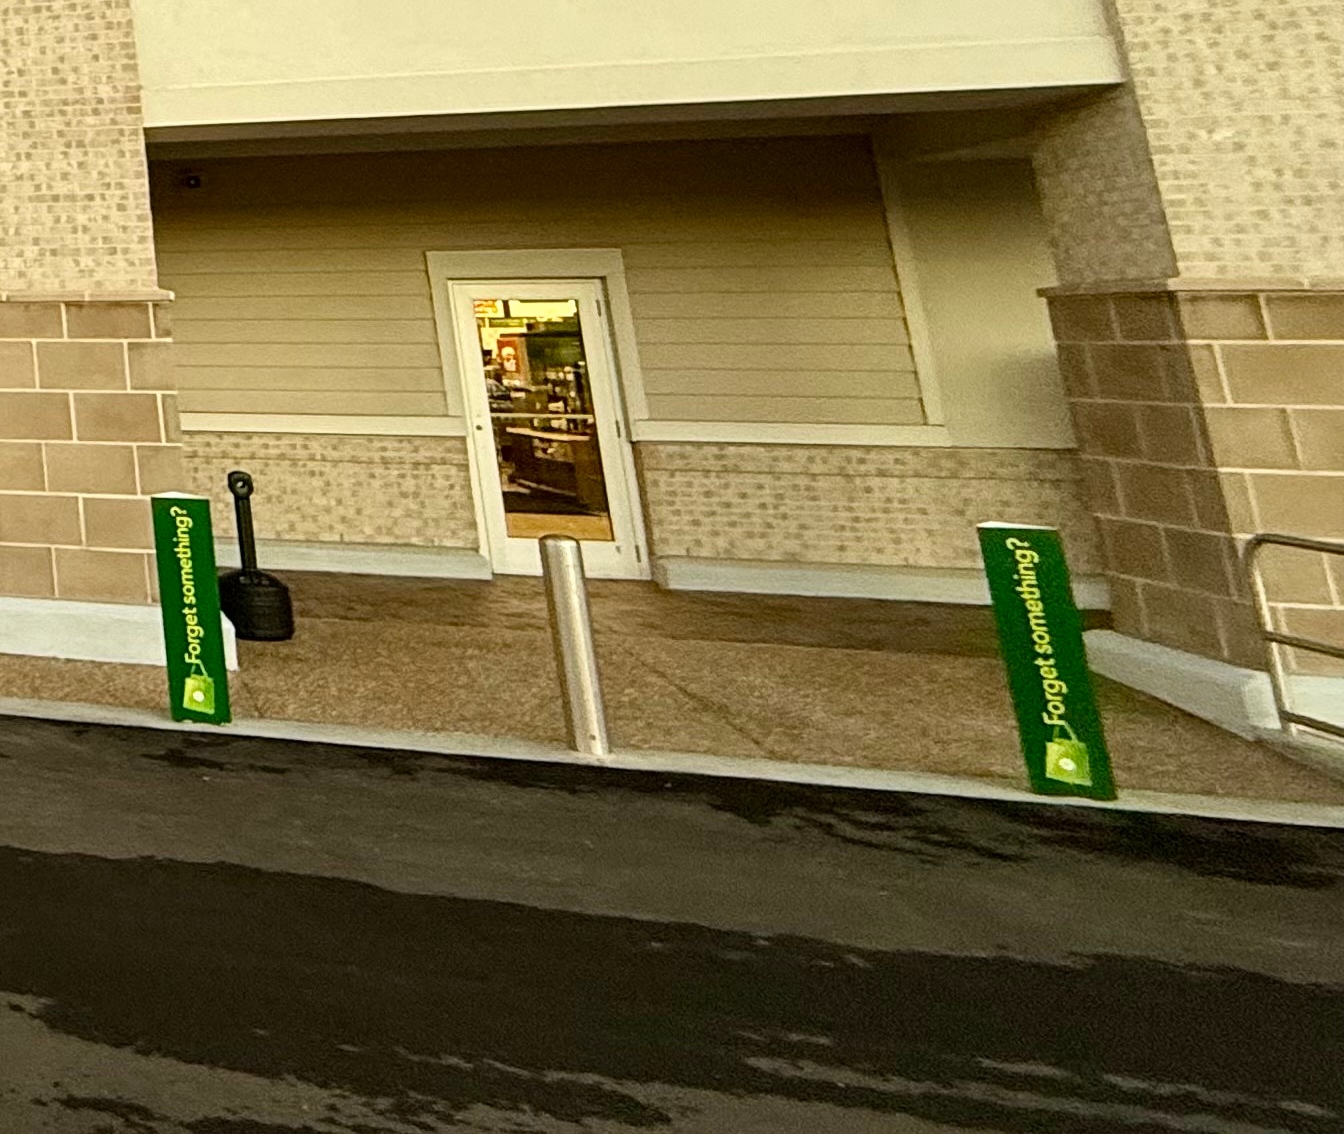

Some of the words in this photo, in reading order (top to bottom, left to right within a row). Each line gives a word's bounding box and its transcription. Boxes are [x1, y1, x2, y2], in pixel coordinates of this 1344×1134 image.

[169, 505, 196, 604] something?
[1005, 537, 1054, 655] something?
[182, 607, 205, 664] Forget
[1033, 657, 1070, 726] Forget
